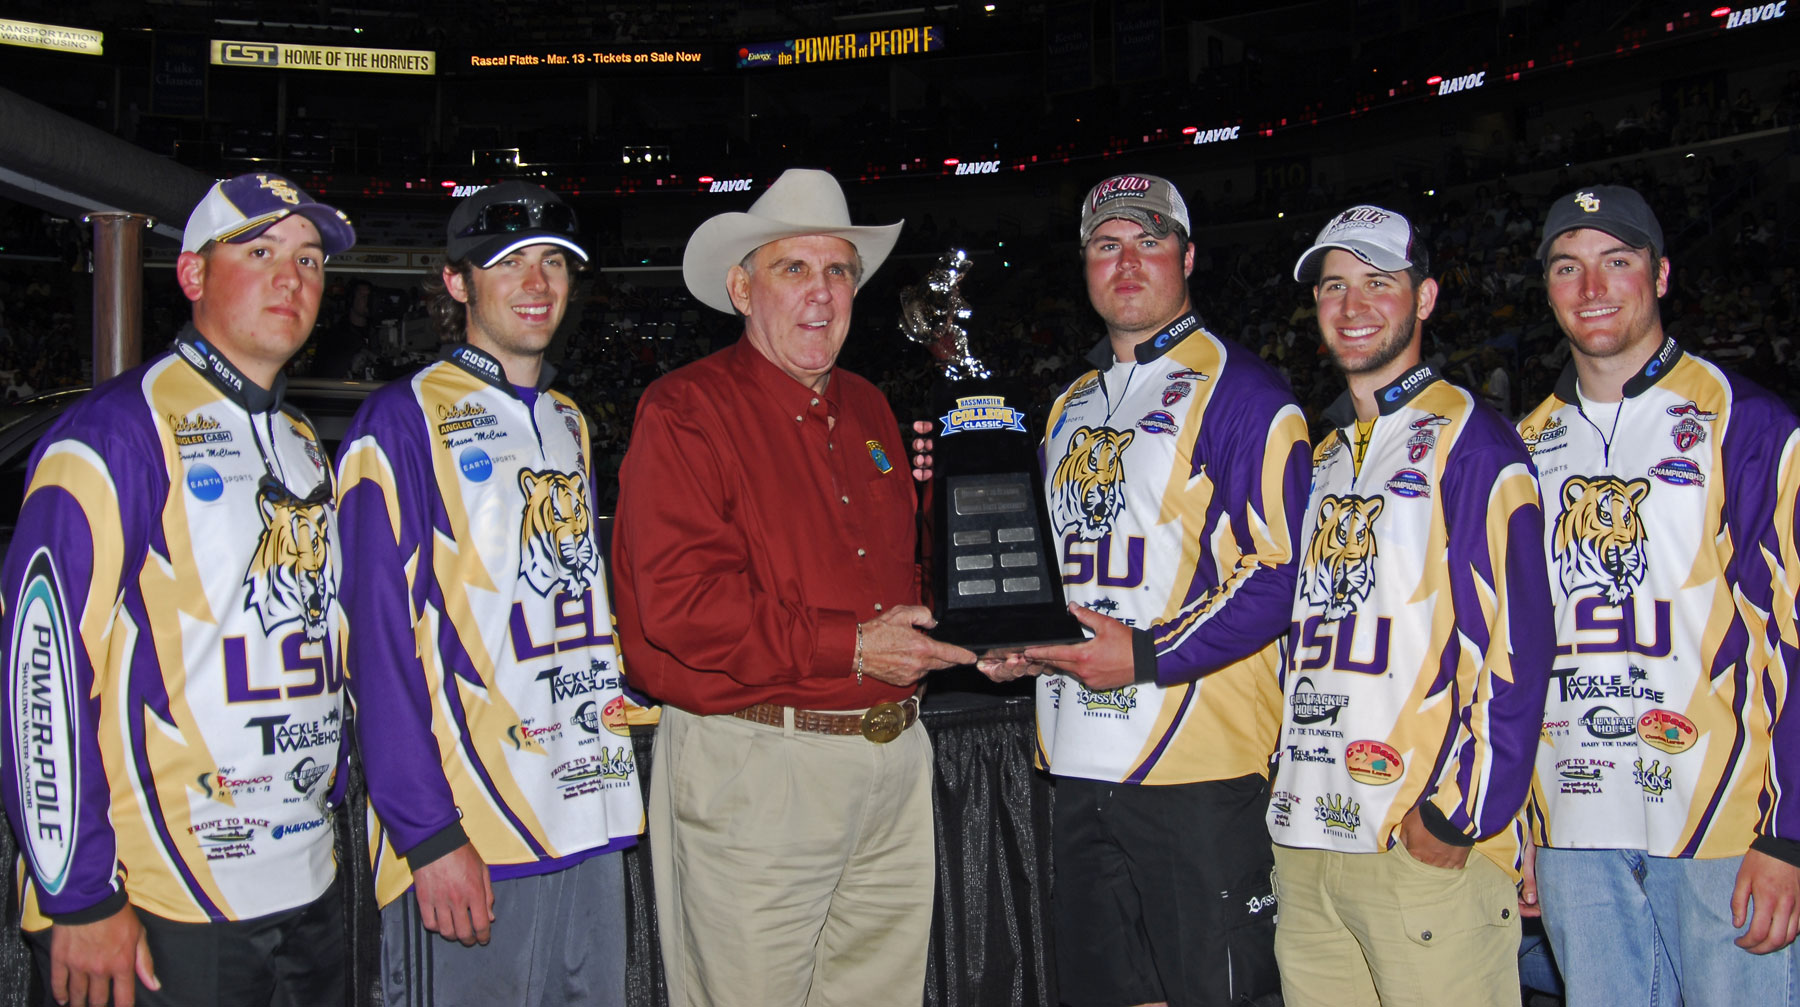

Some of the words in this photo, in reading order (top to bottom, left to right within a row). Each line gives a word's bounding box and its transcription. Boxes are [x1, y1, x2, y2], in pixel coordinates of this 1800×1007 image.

[1726, 0, 1787, 29] HAVOC
[1, 33, 87, 49] WAREHOUSING
[778, 52, 792, 65] the
[795, 33, 856, 64] POWER
[859, 45, 868, 58] of
[225, 45, 274, 63] CST
[285, 49, 322, 66] HOME
[325, 50, 341, 66] OF
[344, 52, 367, 68] THE
[371, 53, 429, 71] HORNETS
[471, 55, 507, 66] Rascal
[509, 55, 539, 66] Flatts
[547, 54, 569, 65] Mar.
[572, 54, 585, 64] 13
[593, 53, 631, 64] Tickets
[634, 54, 648, 63] on
[650, 52, 674, 62] Sale
[676, 52, 701, 62] Now
[1438, 71, 1485, 96] HAVOC
[1193, 126, 1241, 145] HAVOC
[955, 160, 1000, 175] HAVOC
[451, 185, 488, 197] HAV
[709, 179, 753, 193] HAVOC
[1574, 192, 1600, 212] LSU
[1169, 315, 1196, 337] COSTA
[1659, 336, 1677, 363] COSTA
[461, 349, 499, 376] COSTA
[209, 354, 243, 391] COSTA
[1401, 366, 1432, 391] COSTA
[436, 401, 487, 421] Cabela's
[440, 421, 473, 435] ANGLER
[474, 416, 496, 428] CASH
[964, 420, 1001, 429] CLASSIC
[206, 432, 230, 442] CASH
[1542, 428, 1565, 440] CASH
[463, 460, 490, 472] EARTH
[491, 454, 517, 464] SPORTS
[1540, 464, 1568, 478] SPORTS
[189, 478, 221, 489] EARTH
[223, 474, 253, 484] SPORTS
[1648, 466, 1706, 483] CHAMPIONSHIP
[1384, 480, 1431, 494] CHAMPIONSHIP
[1062, 533, 1146, 589] SU
[21, 661, 29, 718] SHALLOW
[1308, 693, 1350, 708] TACKLE
[1294, 704, 1326, 717] HOUSE
[1541, 720, 1569, 730] ORNADO
[1578, 716, 1611, 726] CAJUN
[1596, 724, 1632, 734] HOUSE
[21, 720, 30, 759] WATER
[31, 623, 62, 842] POWER-POLE
[243, 713, 319, 756] TACKLE
[1308, 728, 1345, 739] TUNGSTEN
[573, 757, 586, 766] TO
[590, 755, 602, 763] BA
[1555, 759, 1572, 771] FRONT
[1589, 759, 1616, 770] BACK
[23, 764, 33, 809] ANCHOR
[187, 819, 222, 835] FRONT
[225, 818, 240, 826] TO
[243, 817, 270, 829] BACK
